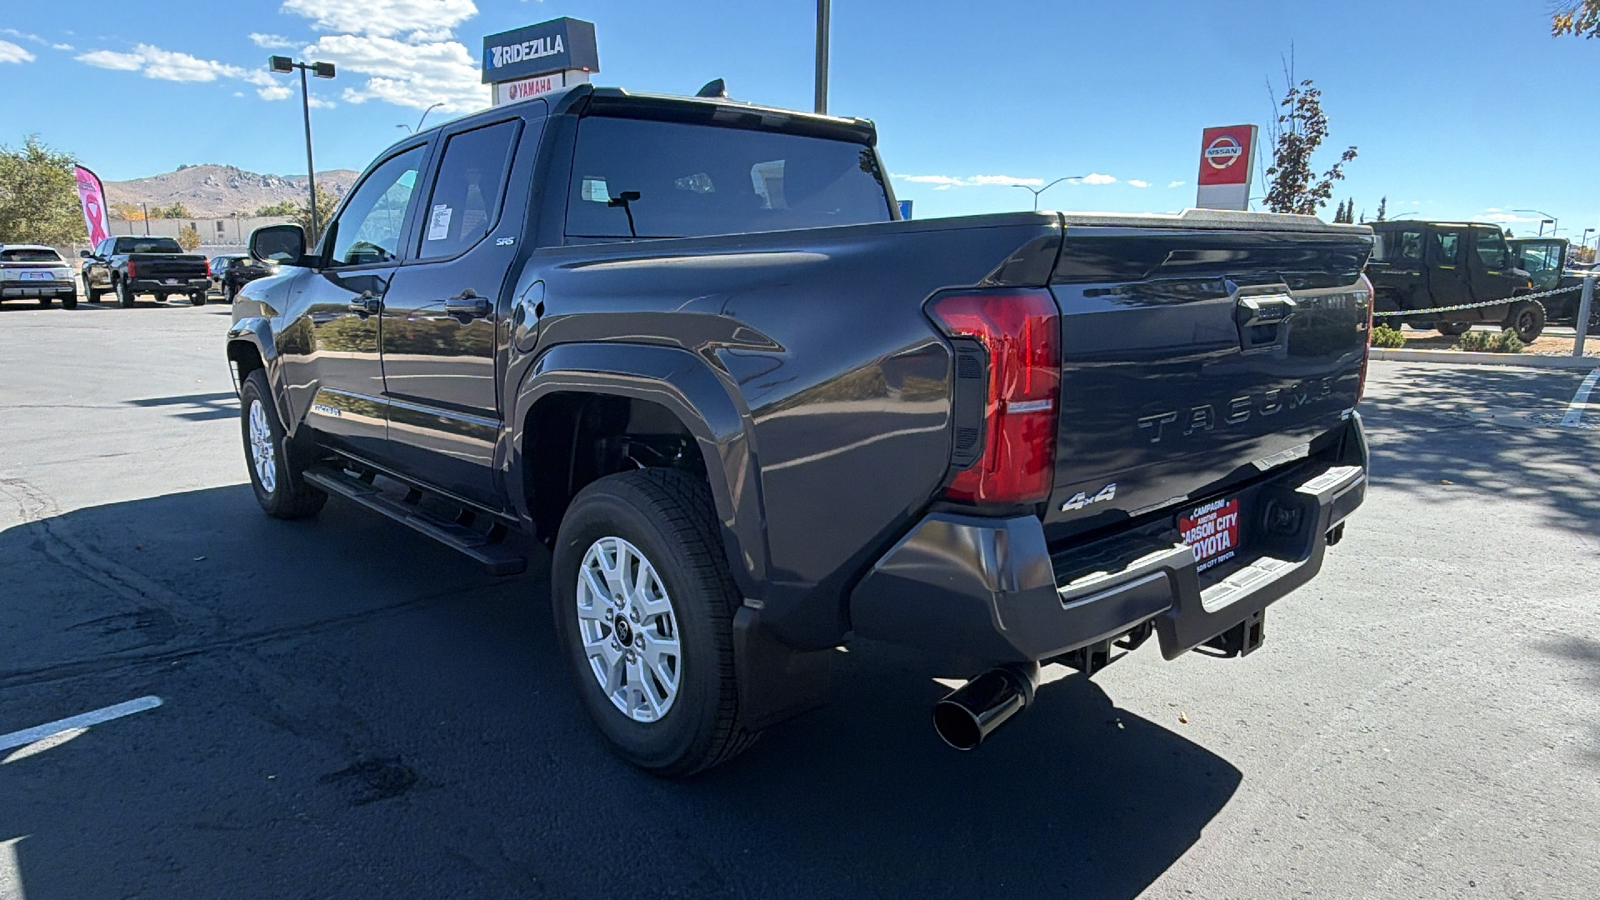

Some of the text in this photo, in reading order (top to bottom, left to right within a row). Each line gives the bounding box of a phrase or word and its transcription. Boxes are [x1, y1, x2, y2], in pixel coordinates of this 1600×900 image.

[503, 35, 564, 64] RIDEZILLA
[518, 79, 551, 98] YAMAHA
[1207, 148, 1238, 156] NISSAN
[1138, 376, 1331, 443] TACOMA
[1217, 512, 1237, 531] CITY
[1192, 530, 1230, 562] OYOTA
